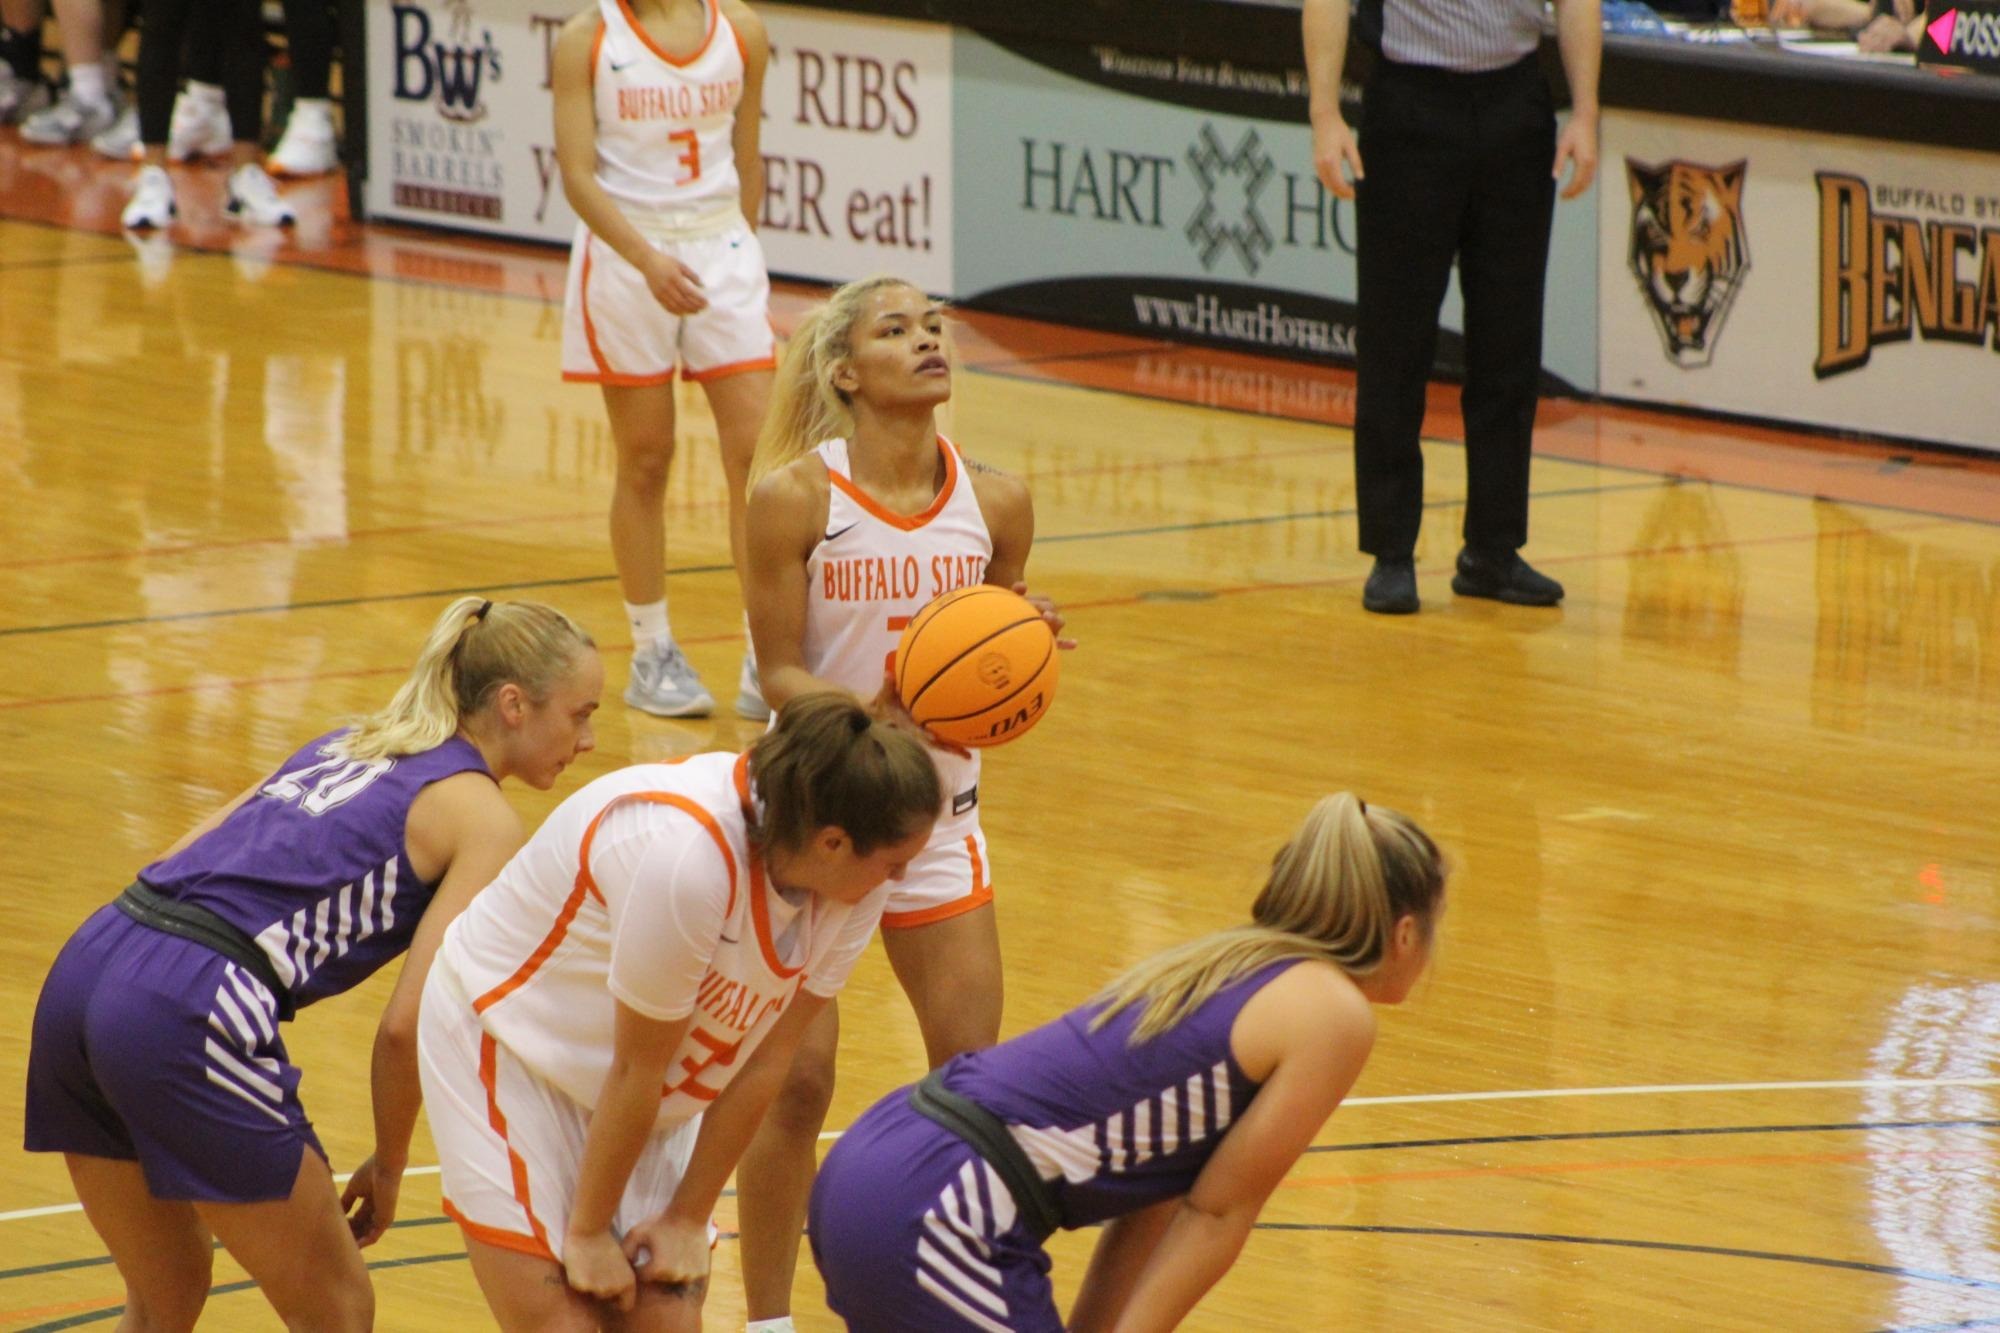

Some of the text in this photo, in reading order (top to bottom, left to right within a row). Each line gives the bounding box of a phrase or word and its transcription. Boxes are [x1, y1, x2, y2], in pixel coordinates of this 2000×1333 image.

[618, 85, 691, 120] BUFFALO
[794, 48, 919, 140] RIBS
[847, 173, 931, 251] eat!
[1020, 135, 1176, 230] HART
[1876, 185, 2000, 219] BUFFALO ST
[823, 555, 910, 602] BUFFALO
